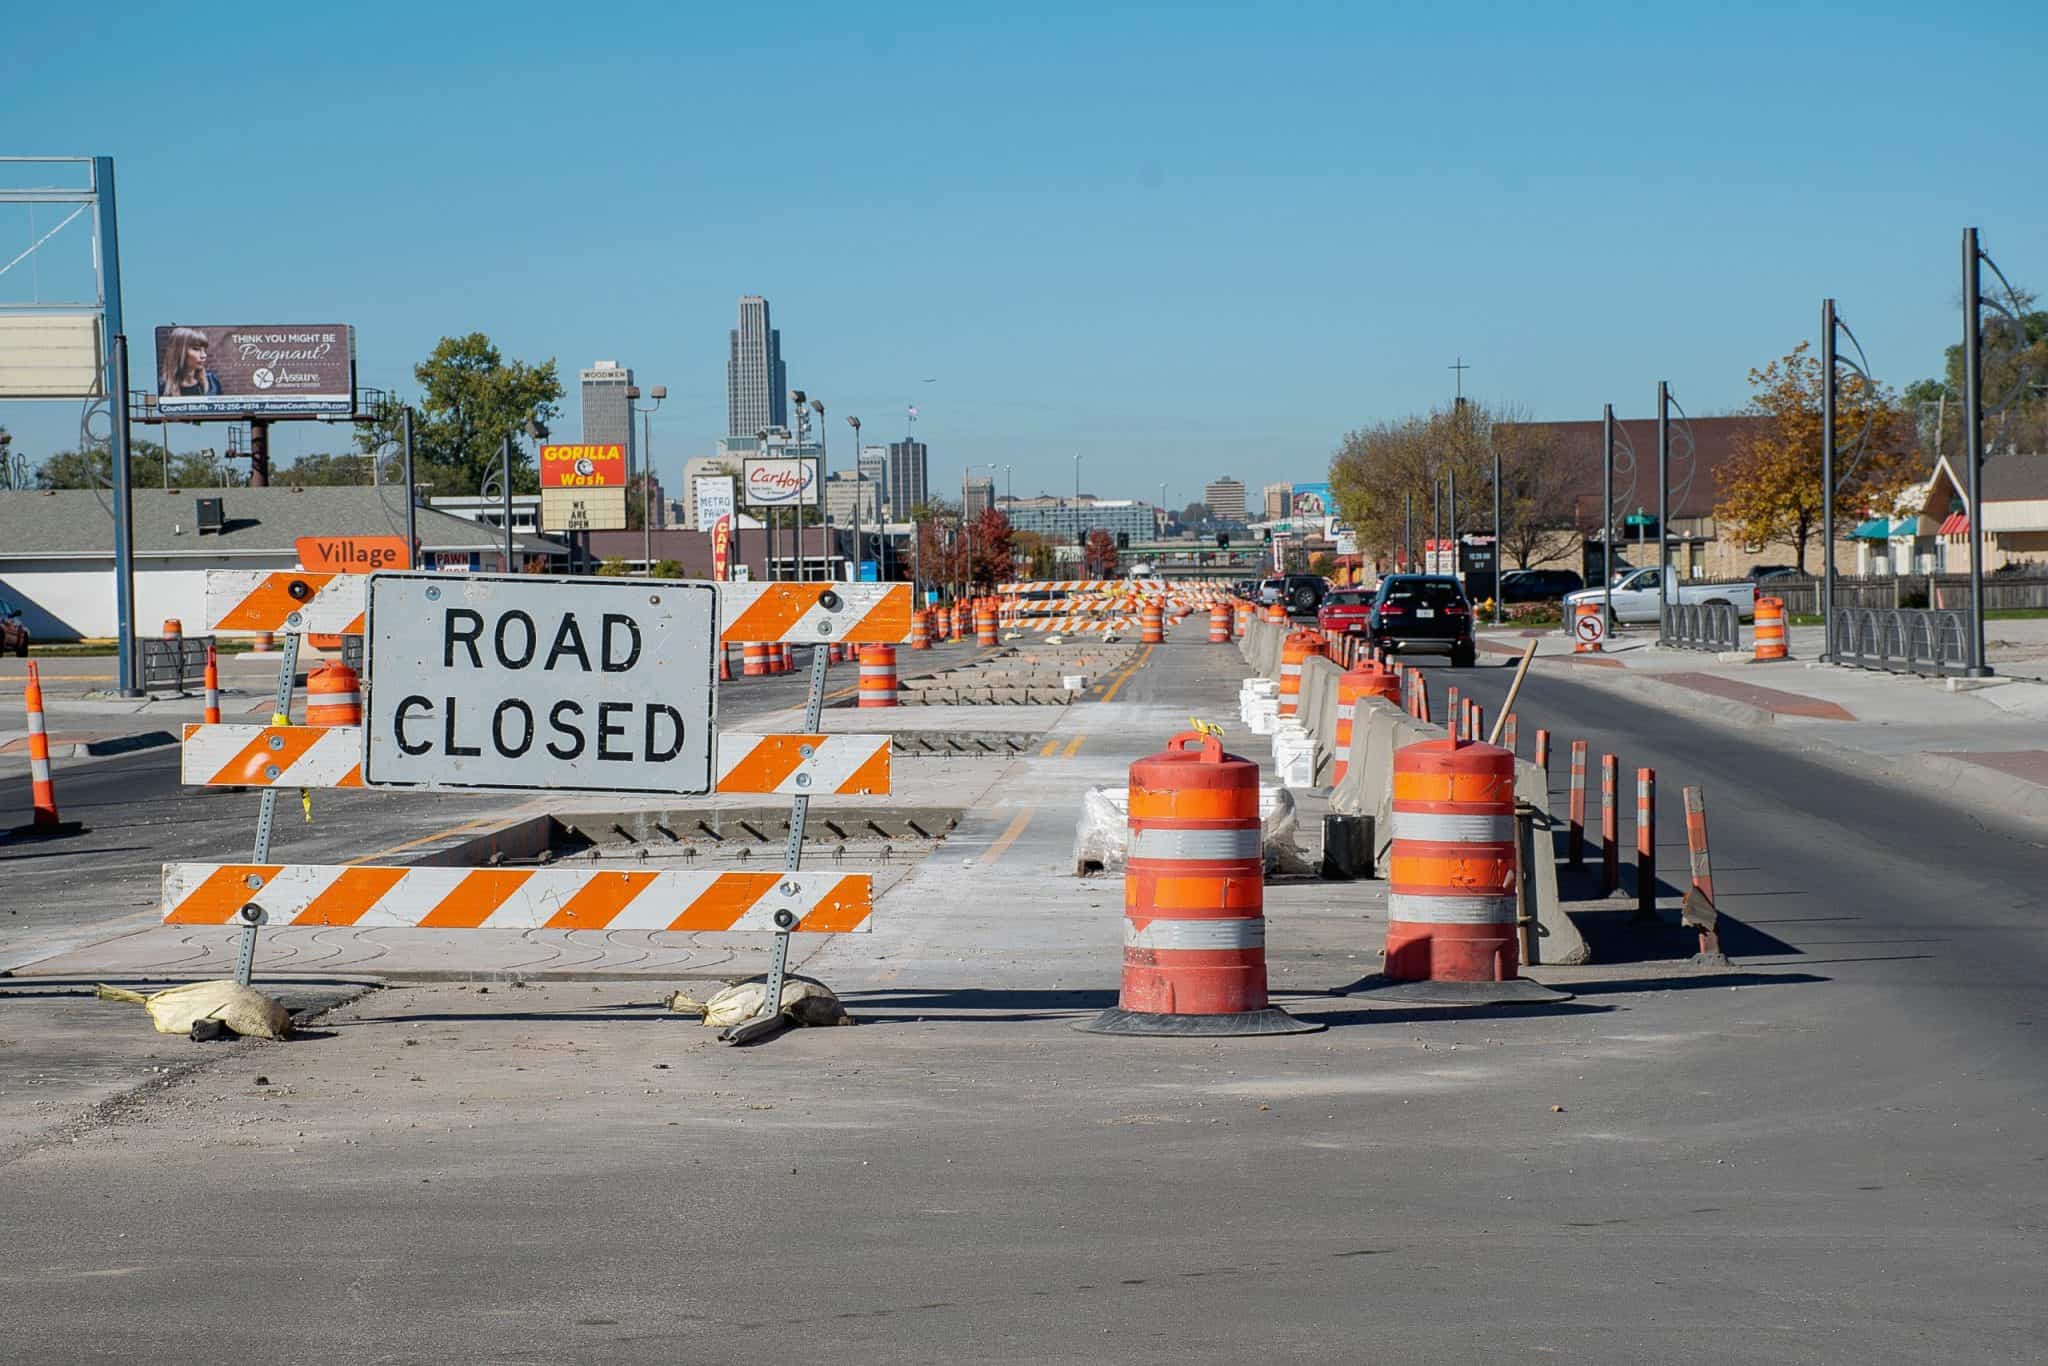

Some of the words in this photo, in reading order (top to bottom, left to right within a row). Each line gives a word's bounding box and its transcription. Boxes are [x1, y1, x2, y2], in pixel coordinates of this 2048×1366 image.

[232, 334, 265, 343] THINK
[265, 334, 287, 343] YOU
[288, 334, 320, 343] MIGHT
[322, 334, 336, 343] BE
[239, 343, 330, 368] Pregnant?
[275, 367, 320, 384] Assure
[543, 446, 620, 461] GORILLA
[560, 472, 605, 486] Wash
[750, 466, 807, 493] CarHop
[572, 501, 585, 510] WE
[700, 496, 730, 507] METRO
[570, 510, 587, 520] ARE
[568, 519, 589, 529] OPEN
[715, 522, 728, 554] CAR
[317, 541, 397, 568] Village
[437, 552, 468, 565] PAWN
[443, 607, 642, 673] ROAD
[393, 694, 685, 763] CLOSED
